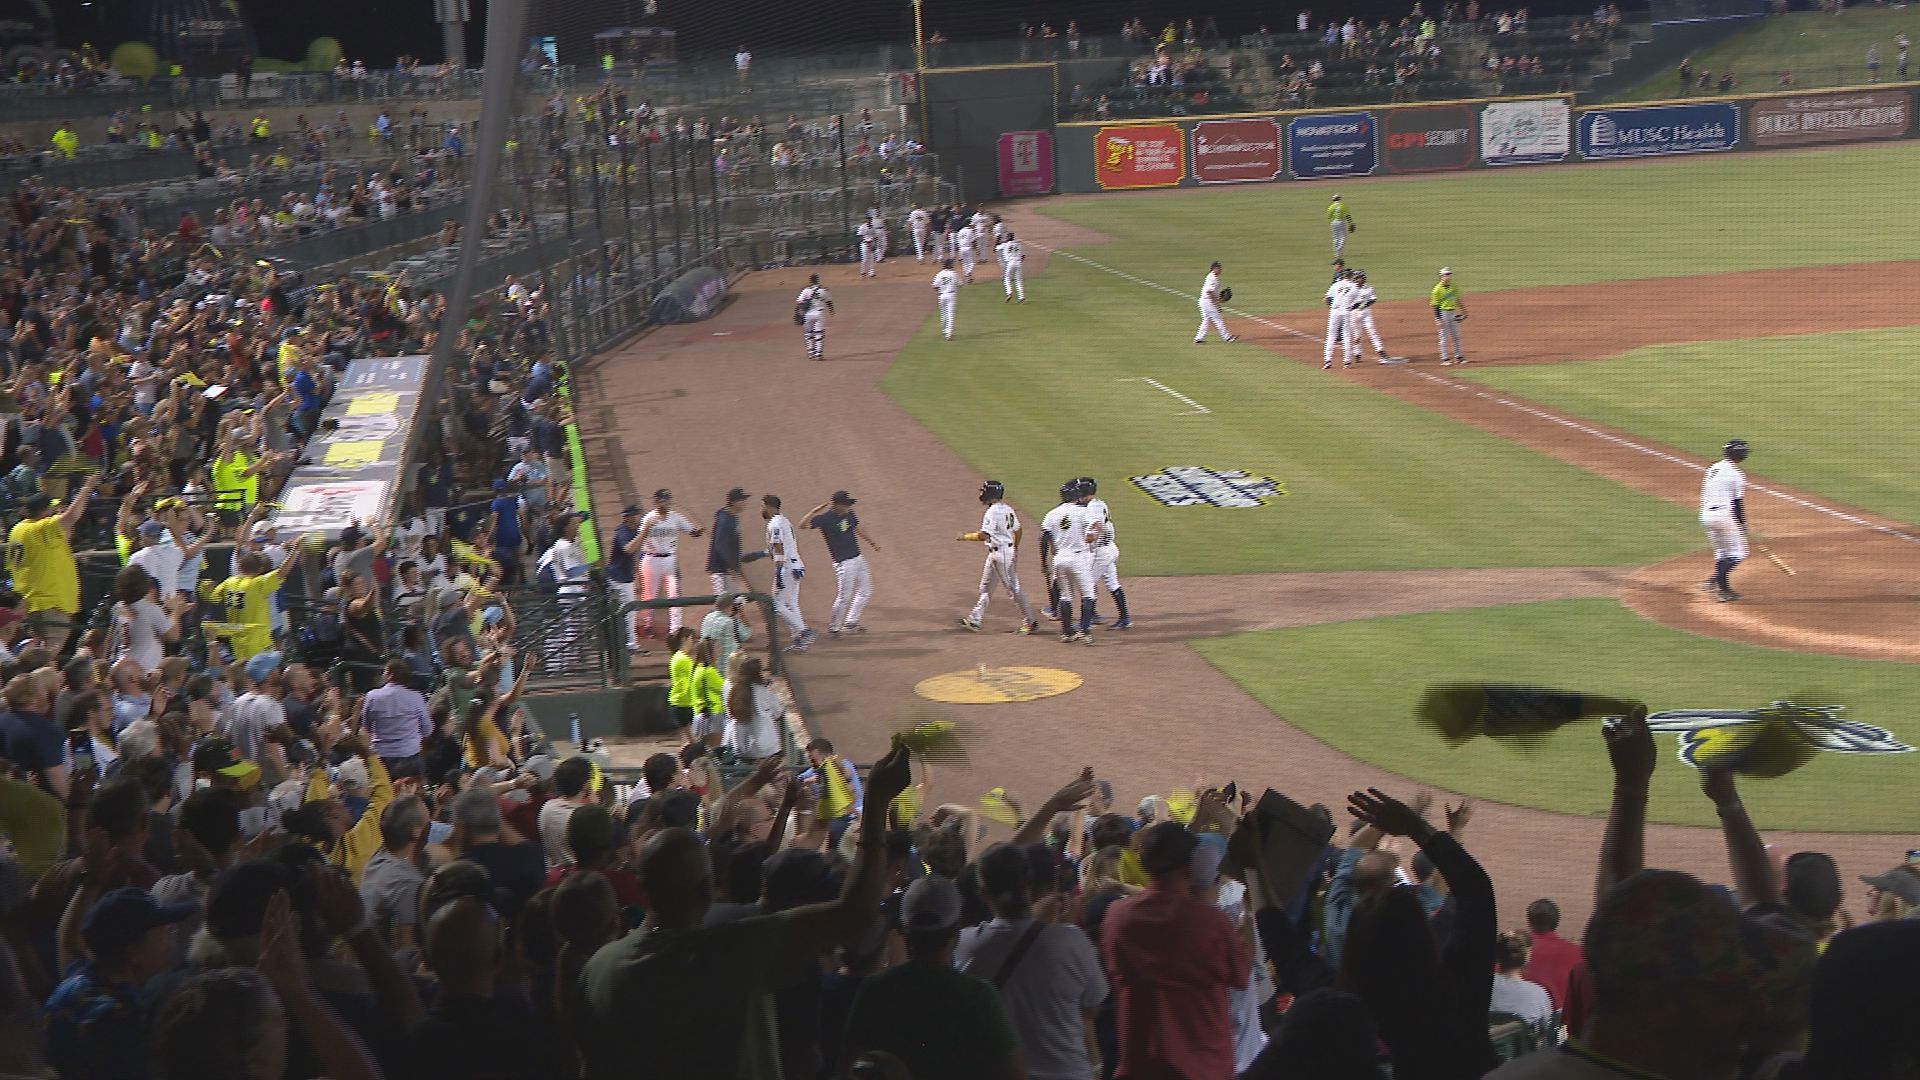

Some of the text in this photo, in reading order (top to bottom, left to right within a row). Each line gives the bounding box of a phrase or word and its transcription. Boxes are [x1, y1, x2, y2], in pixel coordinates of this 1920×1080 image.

[1757, 105, 1903, 133] DUKES INVESTIGATIONS
[1295, 122, 1357, 137] NOVATECH
[1424, 127, 1469, 146] SECURITY
[1618, 122, 1724, 144] MUSC Health
[1060, 513, 1071, 531] 6
